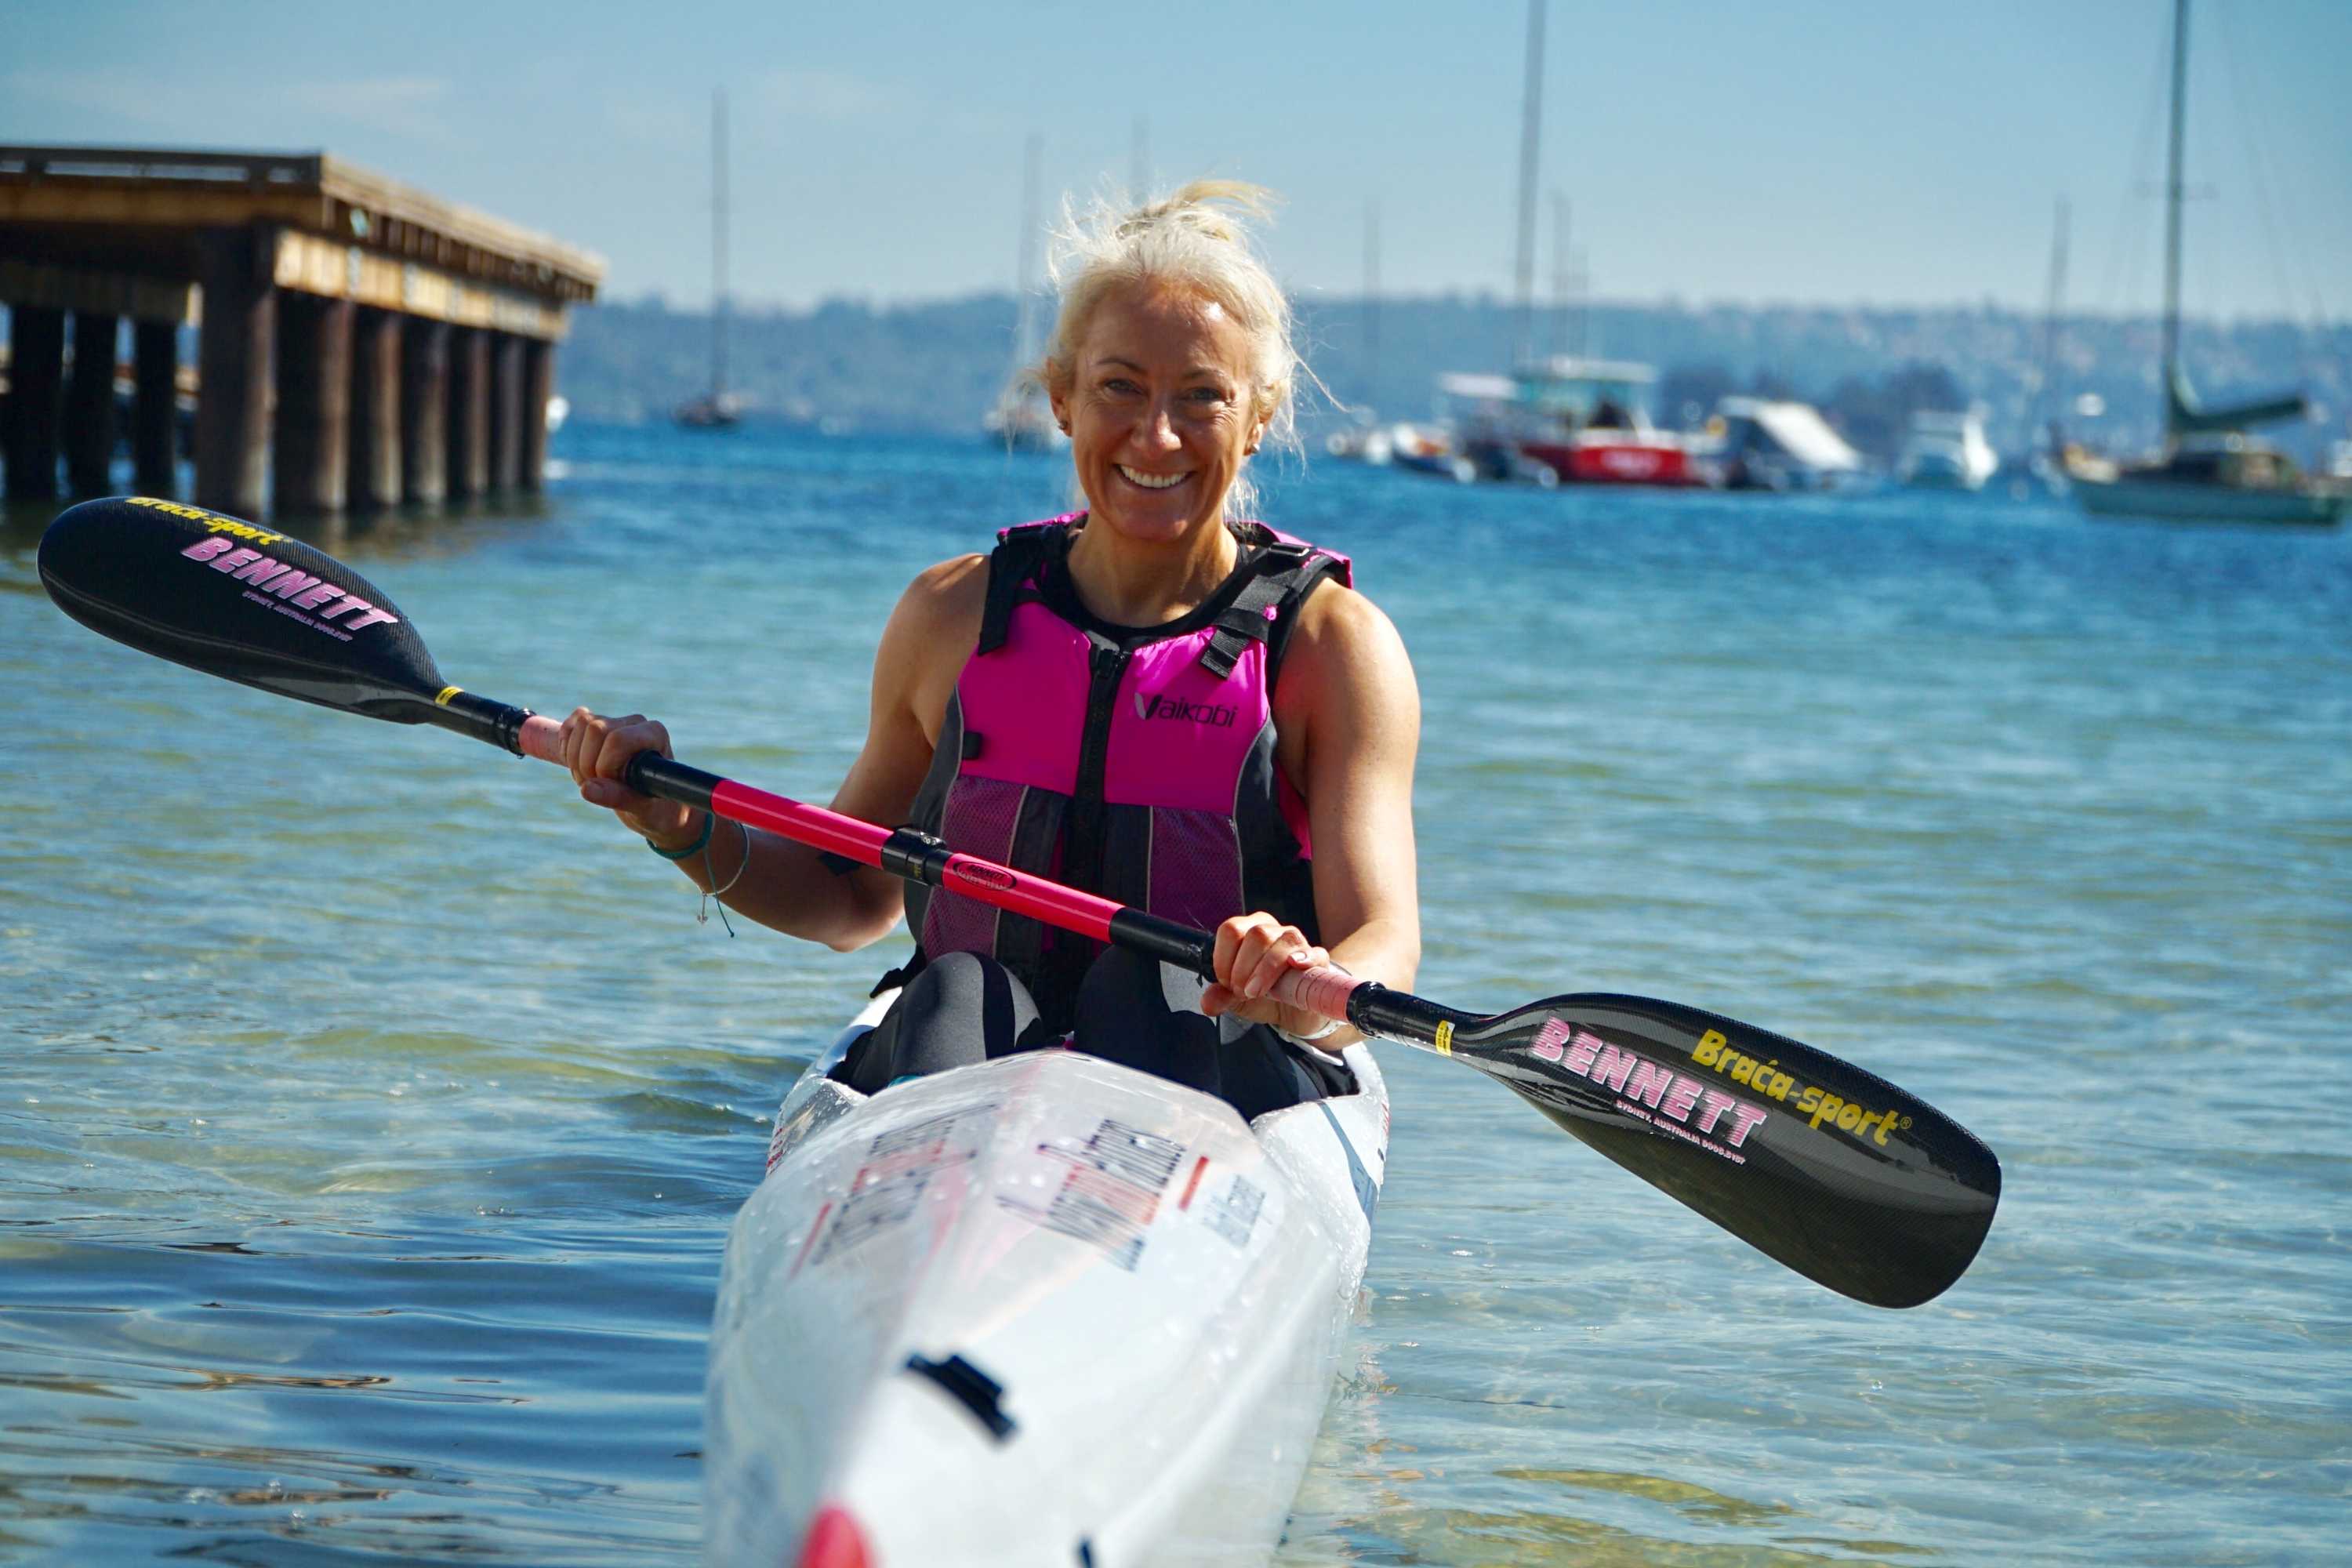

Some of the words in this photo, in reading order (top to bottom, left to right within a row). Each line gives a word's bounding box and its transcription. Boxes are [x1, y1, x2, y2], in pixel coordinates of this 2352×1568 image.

[180, 536, 398, 631] BENNETT
[1134, 691, 1238, 728] Vaikobi
[1530, 1015, 1767, 1148] BENNETT
[1616, 1099, 1652, 1123] SYDNEY,
[1653, 1116, 1701, 1145] AUSTRALIA
